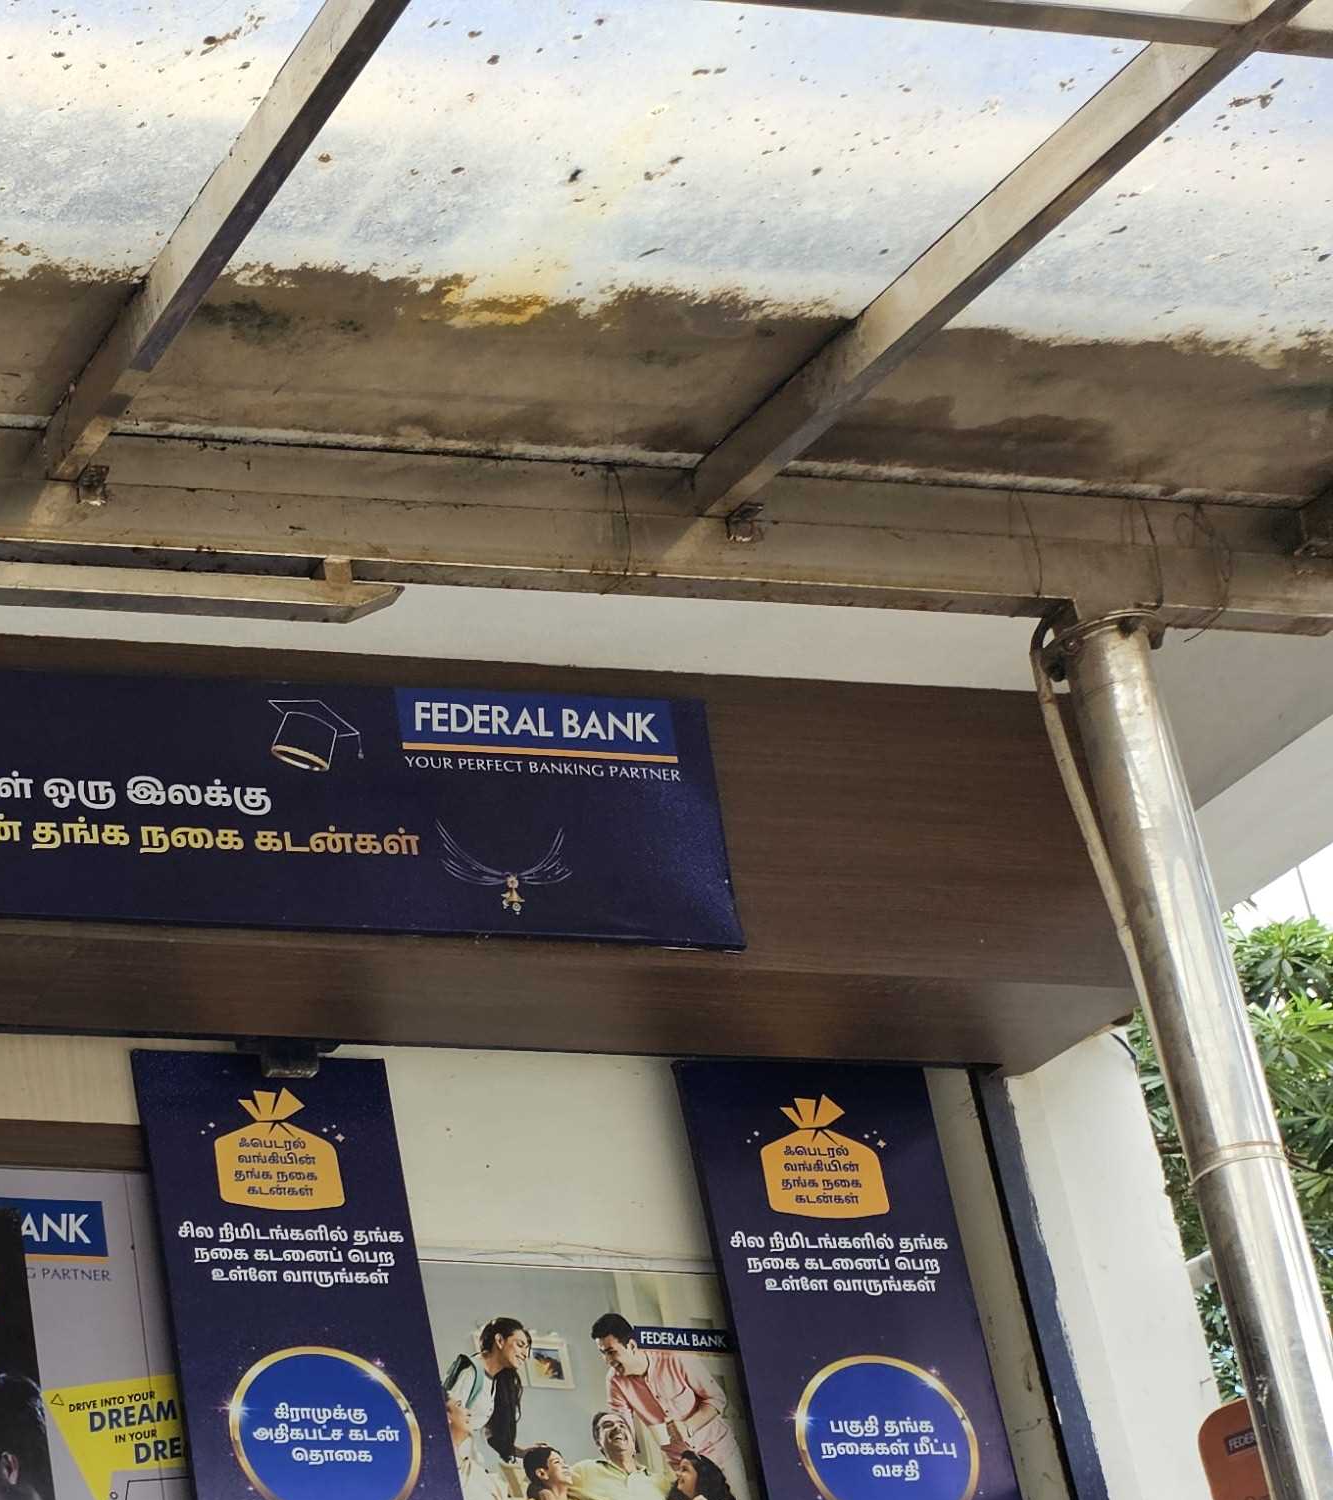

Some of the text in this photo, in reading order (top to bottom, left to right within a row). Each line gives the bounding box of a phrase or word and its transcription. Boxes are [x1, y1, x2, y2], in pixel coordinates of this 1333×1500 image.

[414, 701, 659, 743] FEDERAL BANK
[405, 755, 681, 782] YOUR PERFECT BANKING PARTNER
[43, 776, 116, 810] ஒரு
[126, 776, 272, 815] இலக்கு
[32, 816, 130, 850] தங்க
[140, 824, 244, 854] நகை
[254, 825, 420, 855] கடன்கள்
[234, 1168, 318, 1183] தங்க நகை
[21, 1212, 91, 1244] ANK
[178, 1221, 404, 1246] சில நிமிடங்களில் தங்க
[730, 1231, 948, 1254] சில நிமிடங்களில் தங்க
[194, 1247, 395, 1267] நகை கடனைப் பெற
[747, 1257, 800, 1273] நகை
[895, 1256, 940, 1275] பெற
[41, 1267, 111, 1281] PARTNER
[211, 1267, 389, 1287] உள்ளே வாருங்கள்
[833, 1276, 936, 1296] வாருங்கள்
[640, 1331, 727, 1348] FEDERAL BANK
[69, 1391, 155, 1412] DRIVE INTO YOUR
[89, 1399, 178, 1432] DREAM
[829, 1415, 934, 1437] பகுதி தங்க
[115, 1429, 157, 1443] IN YOUR
[349, 1425, 400, 1442] கடன்
[134, 1437, 182, 1464] DRE
[292, 1446, 373, 1465] தொகை
[820, 1440, 910, 1459] நகைகள்
[872, 1460, 921, 1481] வசதி
